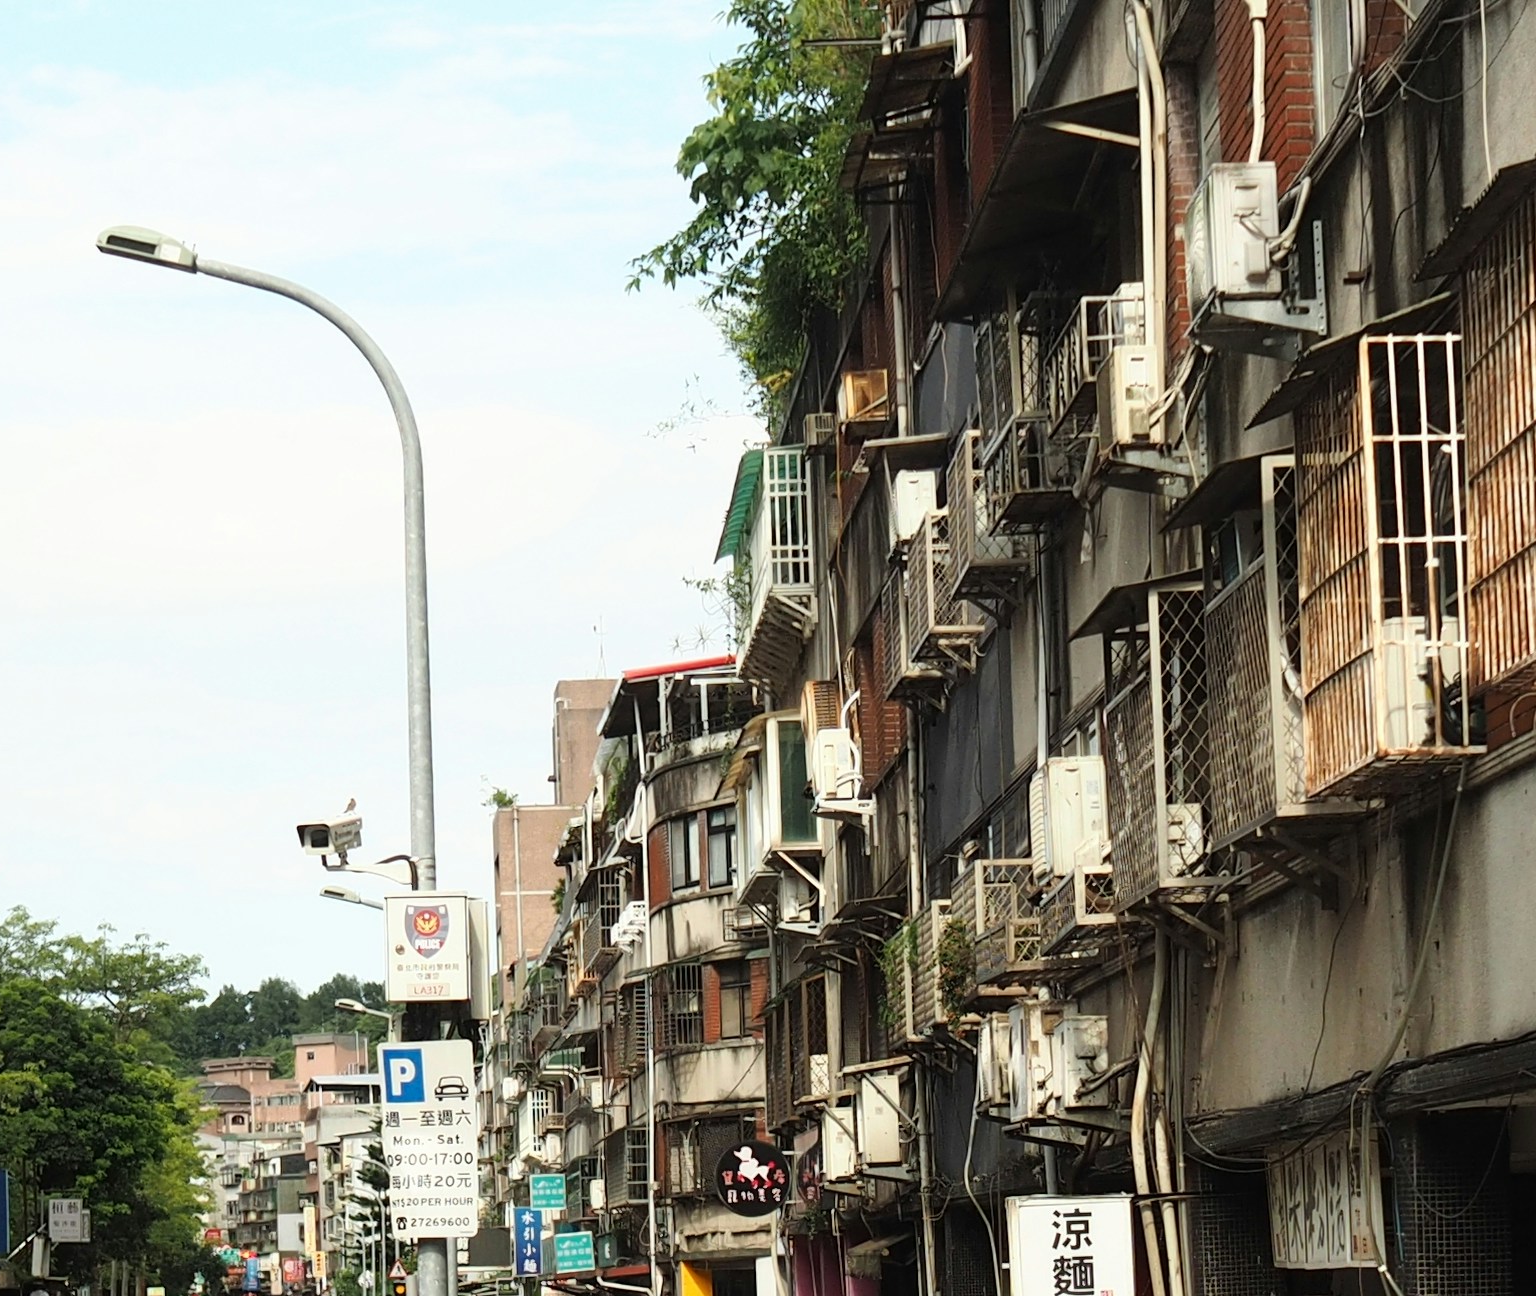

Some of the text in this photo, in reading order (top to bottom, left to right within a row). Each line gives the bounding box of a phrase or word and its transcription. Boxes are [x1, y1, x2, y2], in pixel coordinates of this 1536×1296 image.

[389, 1058, 416, 1096] P
[385, 1108, 472, 1128] 週一至週六
[387, 1152, 474, 1167] 09:00-17:00
[392, 1173, 472, 1190] 每小時20元
[421, 1197, 442, 1206] PER
[444, 1197, 474, 1206] HOUR
[410, 1217, 470, 1227] 27269600
[521, 1211, 537, 1272] 水引小麵
[1051, 1208, 1095, 1296] 涼麵
